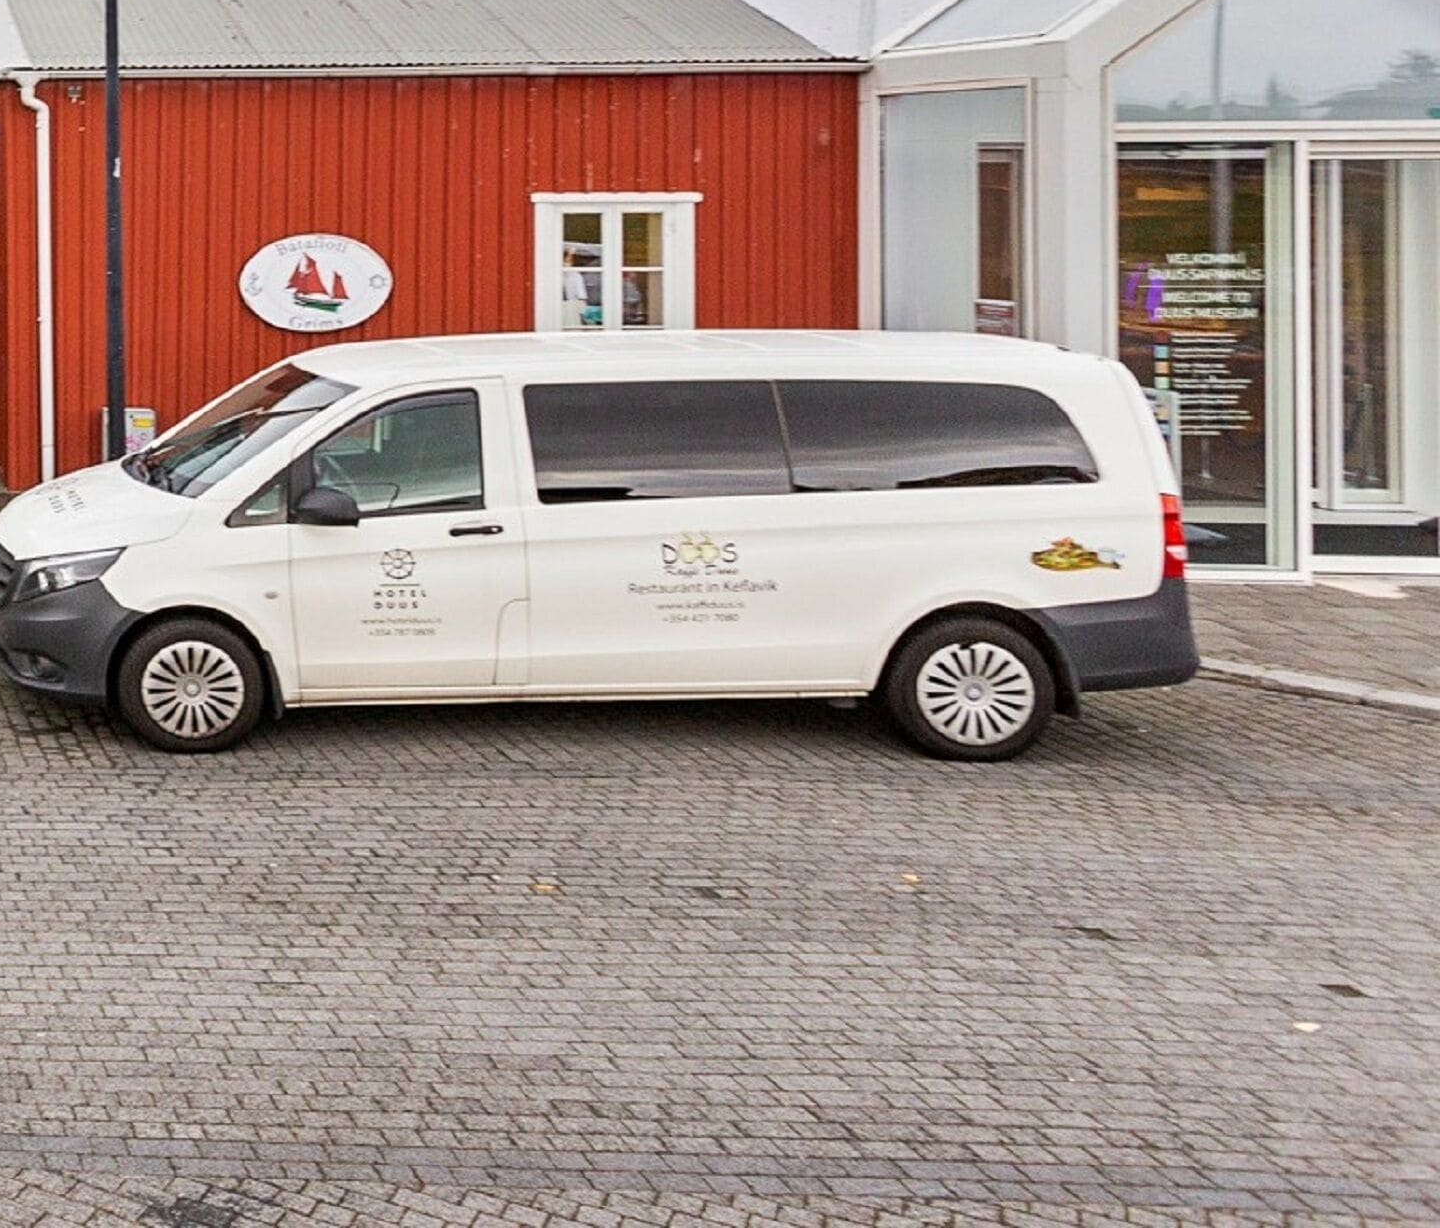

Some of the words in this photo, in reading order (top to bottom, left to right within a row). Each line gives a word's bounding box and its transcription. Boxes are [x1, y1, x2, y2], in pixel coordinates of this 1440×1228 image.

[627, 582, 705, 595] Restaurant
[706, 582, 720, 593] in
[373, 589, 427, 598] HOTEL
[373, 601, 419, 610] DUUS
